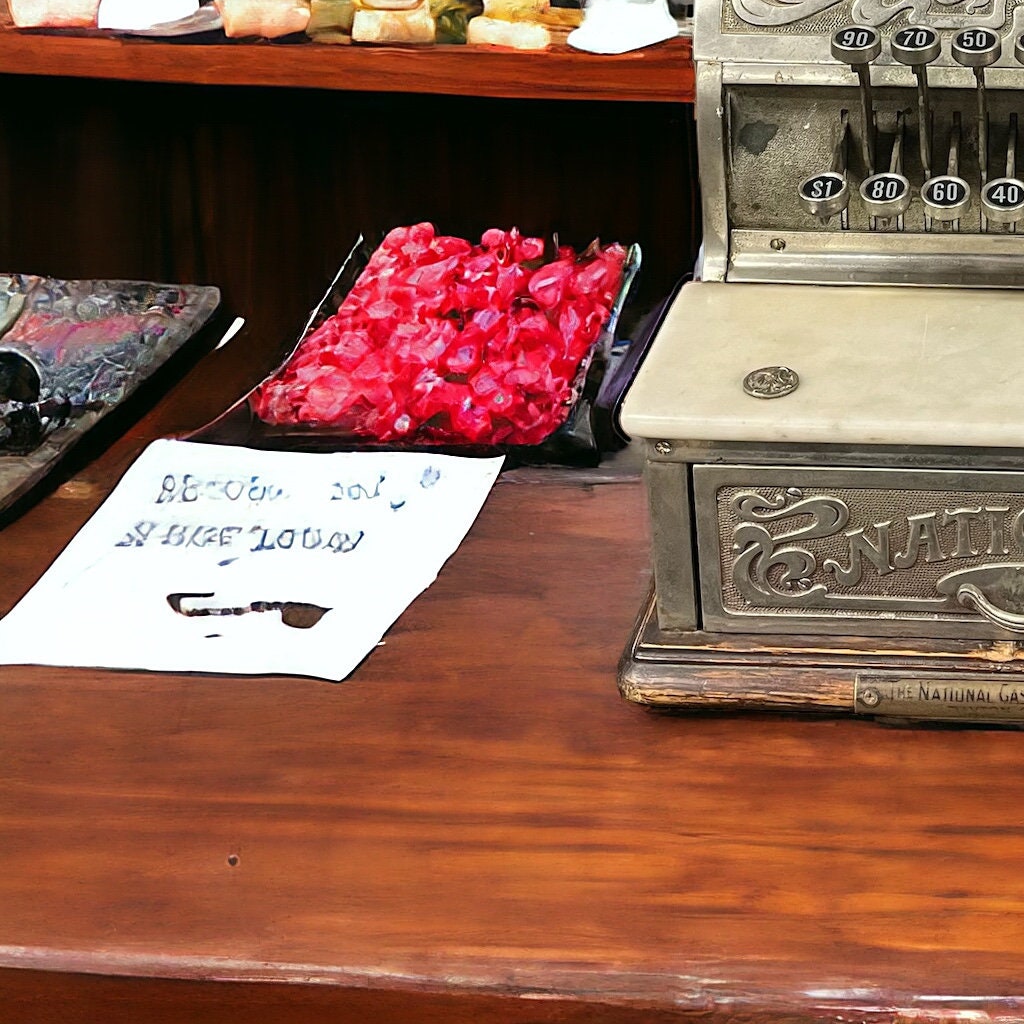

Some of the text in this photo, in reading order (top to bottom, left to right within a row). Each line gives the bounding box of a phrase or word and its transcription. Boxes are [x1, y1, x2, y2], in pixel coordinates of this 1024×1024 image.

[842, 31, 868, 47] 90
[903, 31, 927, 46] 70
[962, 32, 987, 48] 50
[872, 181, 898, 199] 80
[933, 182, 958, 201] 60
[991, 186, 1019, 203] 40
[918, 681, 993, 703] NATIONAL
